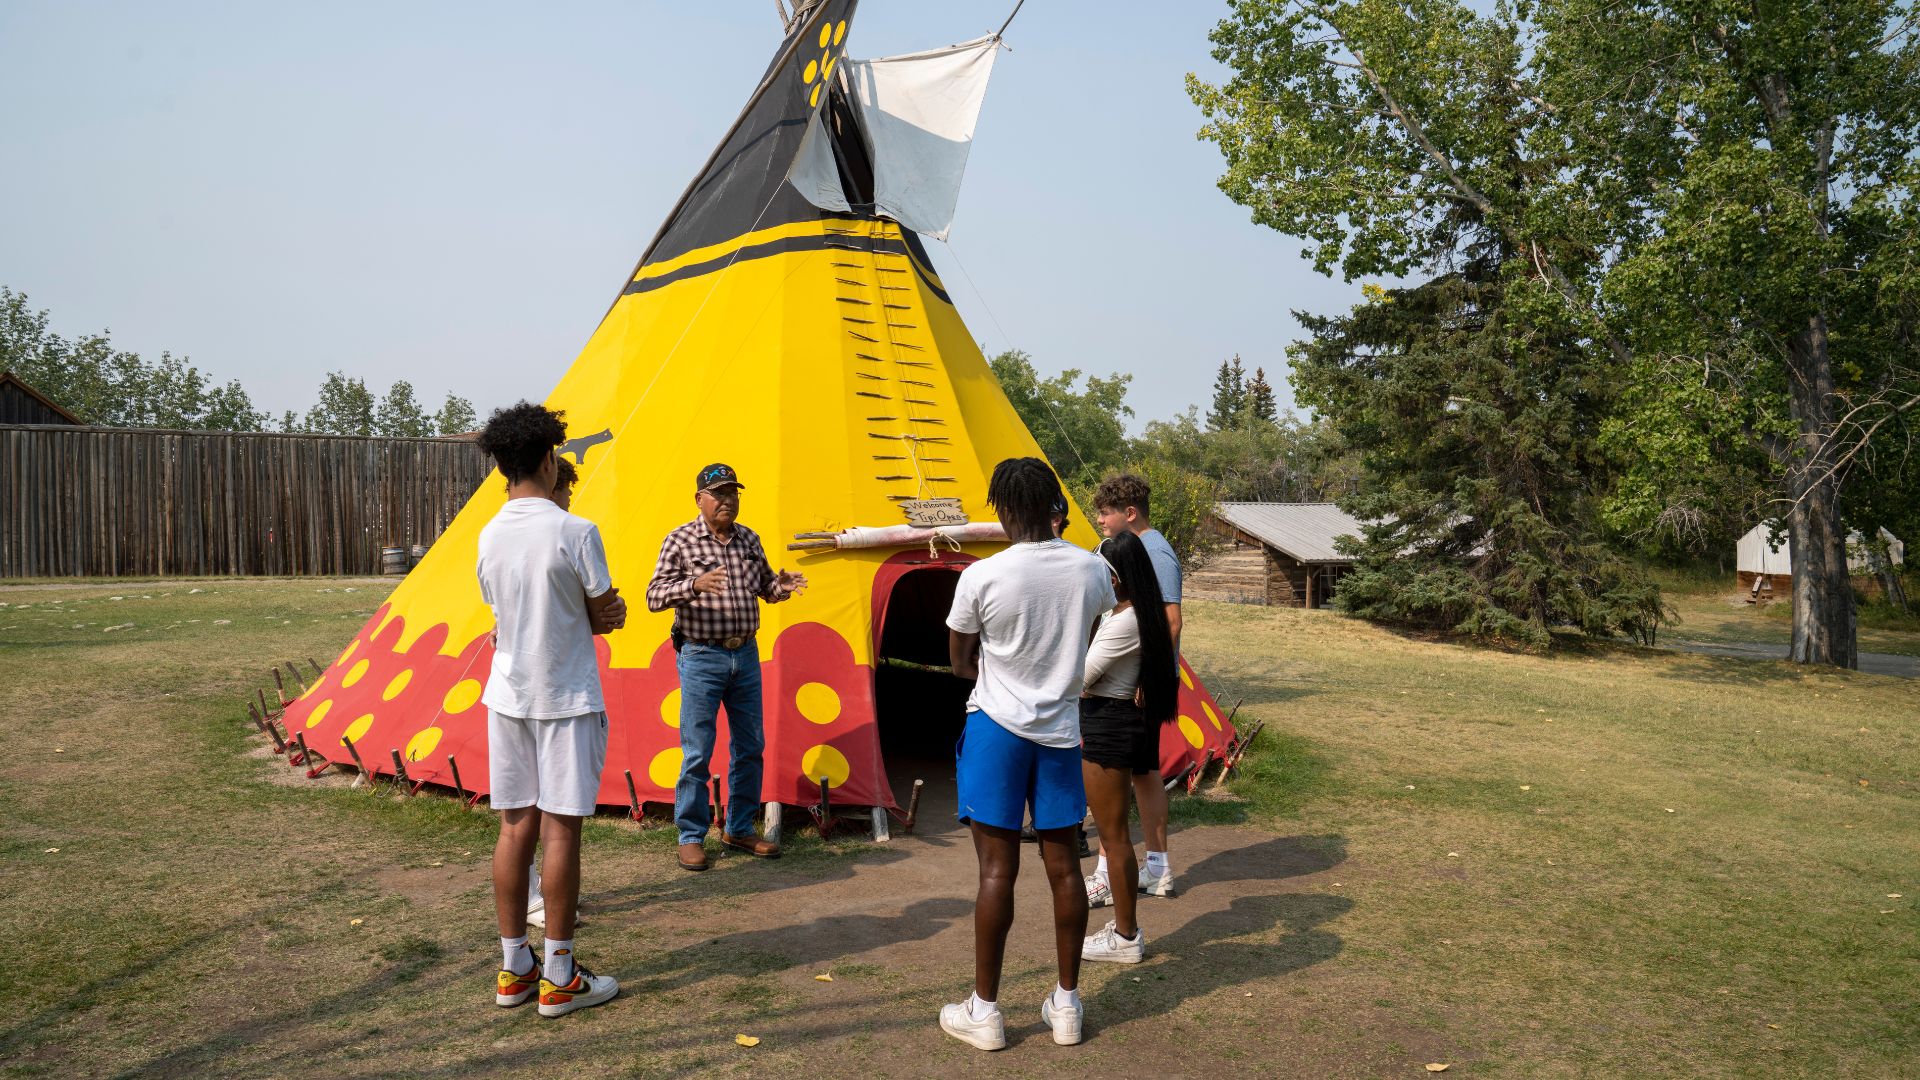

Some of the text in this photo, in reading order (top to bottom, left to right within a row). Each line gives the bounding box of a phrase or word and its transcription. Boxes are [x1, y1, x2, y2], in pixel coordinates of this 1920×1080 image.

[908, 501, 953, 509] Welcome
[915, 510, 962, 524] Tipi Open
